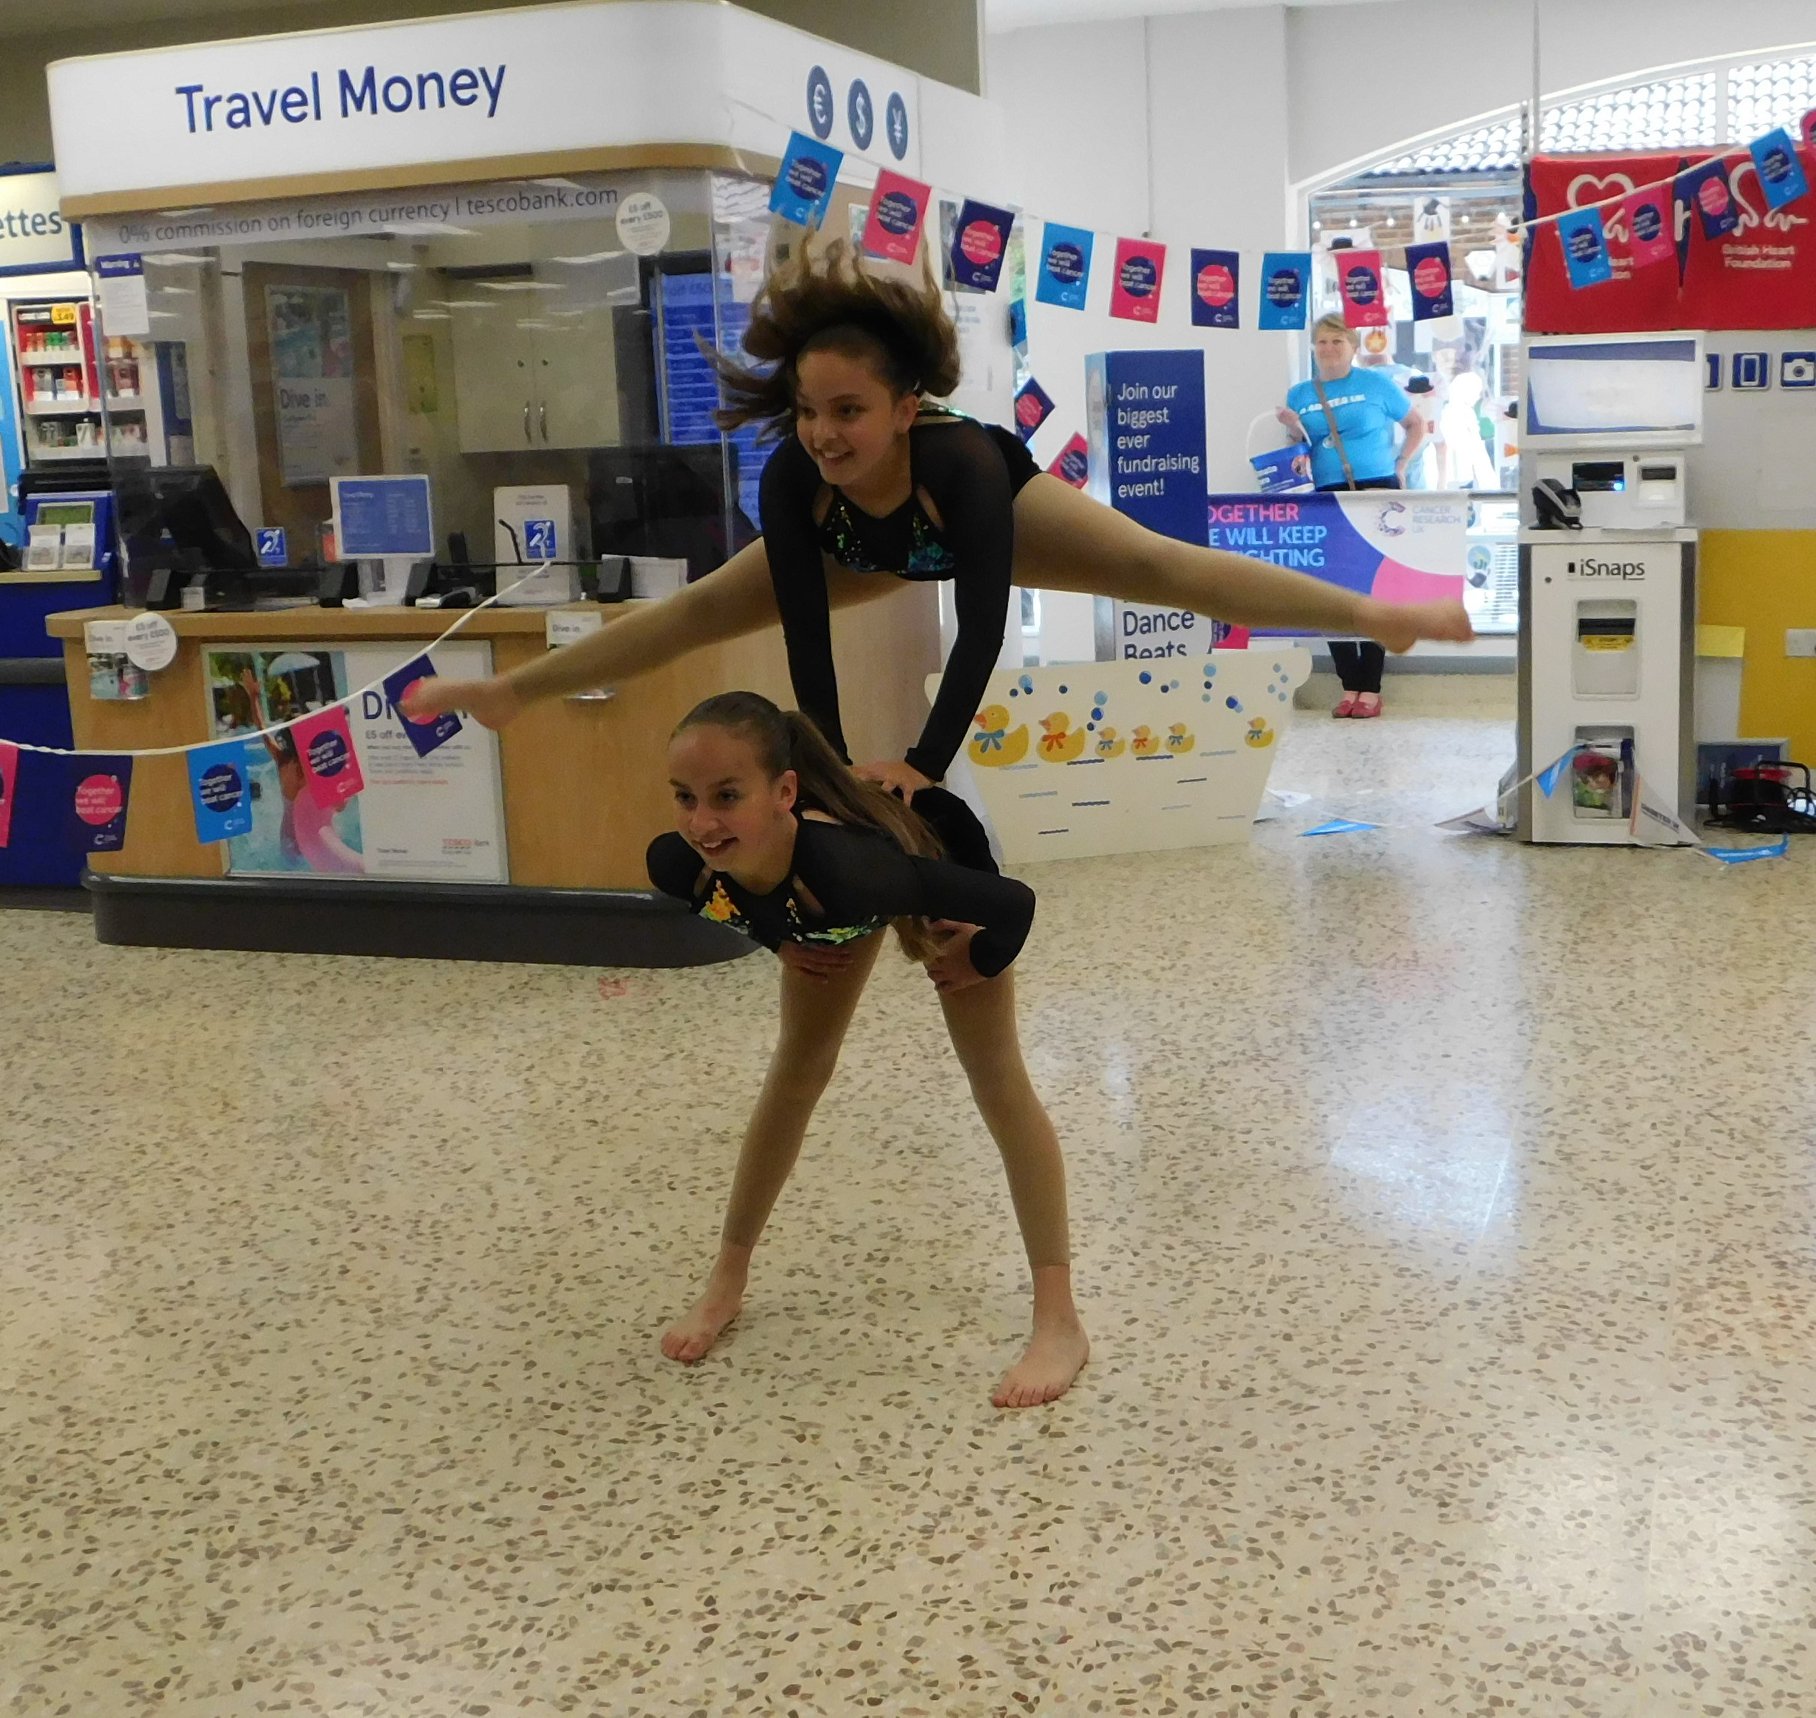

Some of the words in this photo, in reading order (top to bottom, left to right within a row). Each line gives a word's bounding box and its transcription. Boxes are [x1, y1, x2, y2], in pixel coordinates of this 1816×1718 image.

[175, 72, 322, 133] Travel
[338, 64, 506, 119] Money
[155, 217, 262, 241] commission
[268, 216, 290, 230] on
[297, 208, 362, 230] foreign
[368, 200, 450, 224] currency
[467, 187, 618, 215] tescobank.com
[1117, 383, 1149, 401] Join
[1152, 384, 1178, 399] our
[1117, 407, 1170, 429] biggest
[1117, 434, 1151, 449] ever
[1117, 453, 1200, 474] fundraising
[1118, 478, 1165, 498] event!
[1208, 503, 1299, 523] OGETHER
[1209, 528, 1220, 546] E
[1225, 526, 1274, 546] WILL
[1278, 525, 1328, 544] KEEP
[1580, 558, 1645, 580] iSnaps
[1122, 610, 1195, 636] Dance
